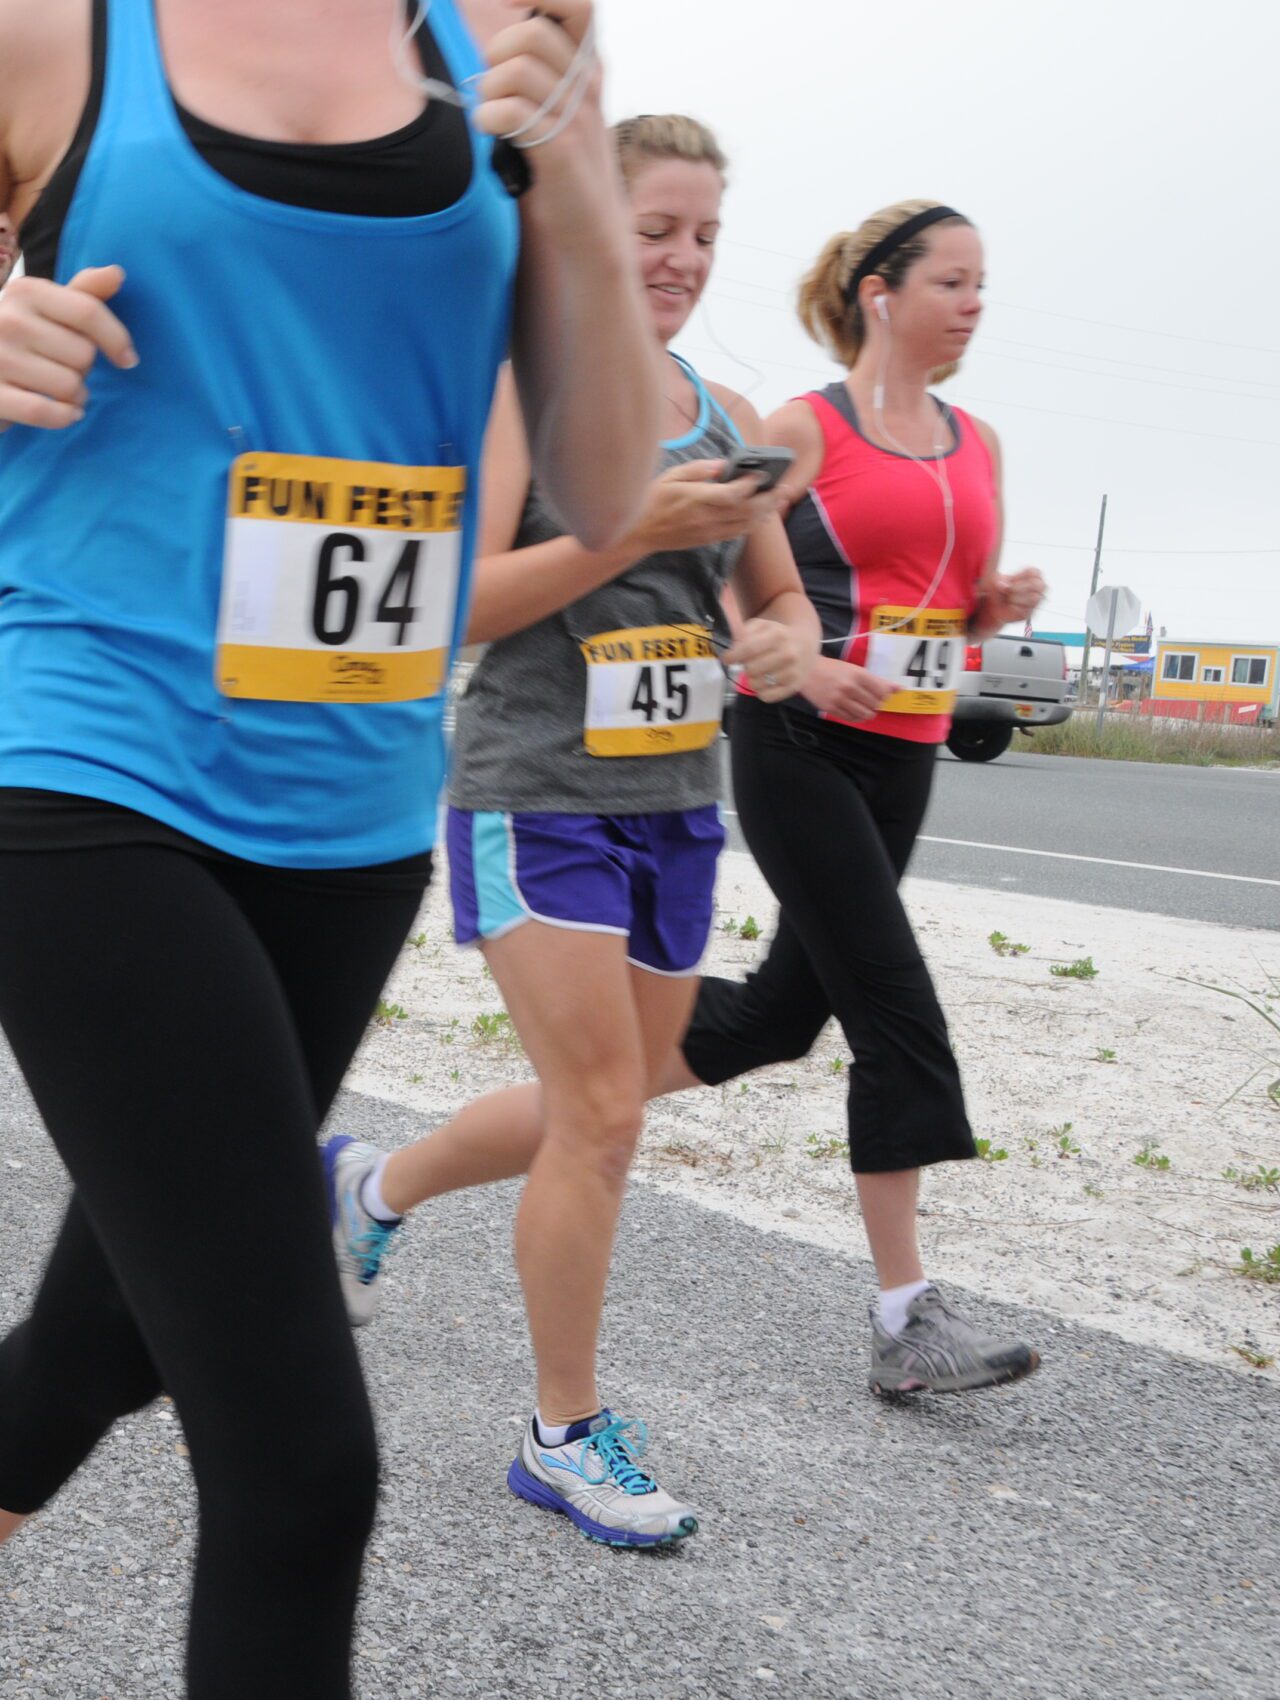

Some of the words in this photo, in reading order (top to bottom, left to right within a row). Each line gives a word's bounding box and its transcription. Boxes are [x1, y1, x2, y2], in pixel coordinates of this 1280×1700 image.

[241, 476, 330, 519] FUN
[346, 485, 441, 527] FEST
[312, 532, 424, 646] 64
[588, 641, 634, 662] FUN
[642, 638, 687, 659] FEST
[630, 664, 689, 722] 45
